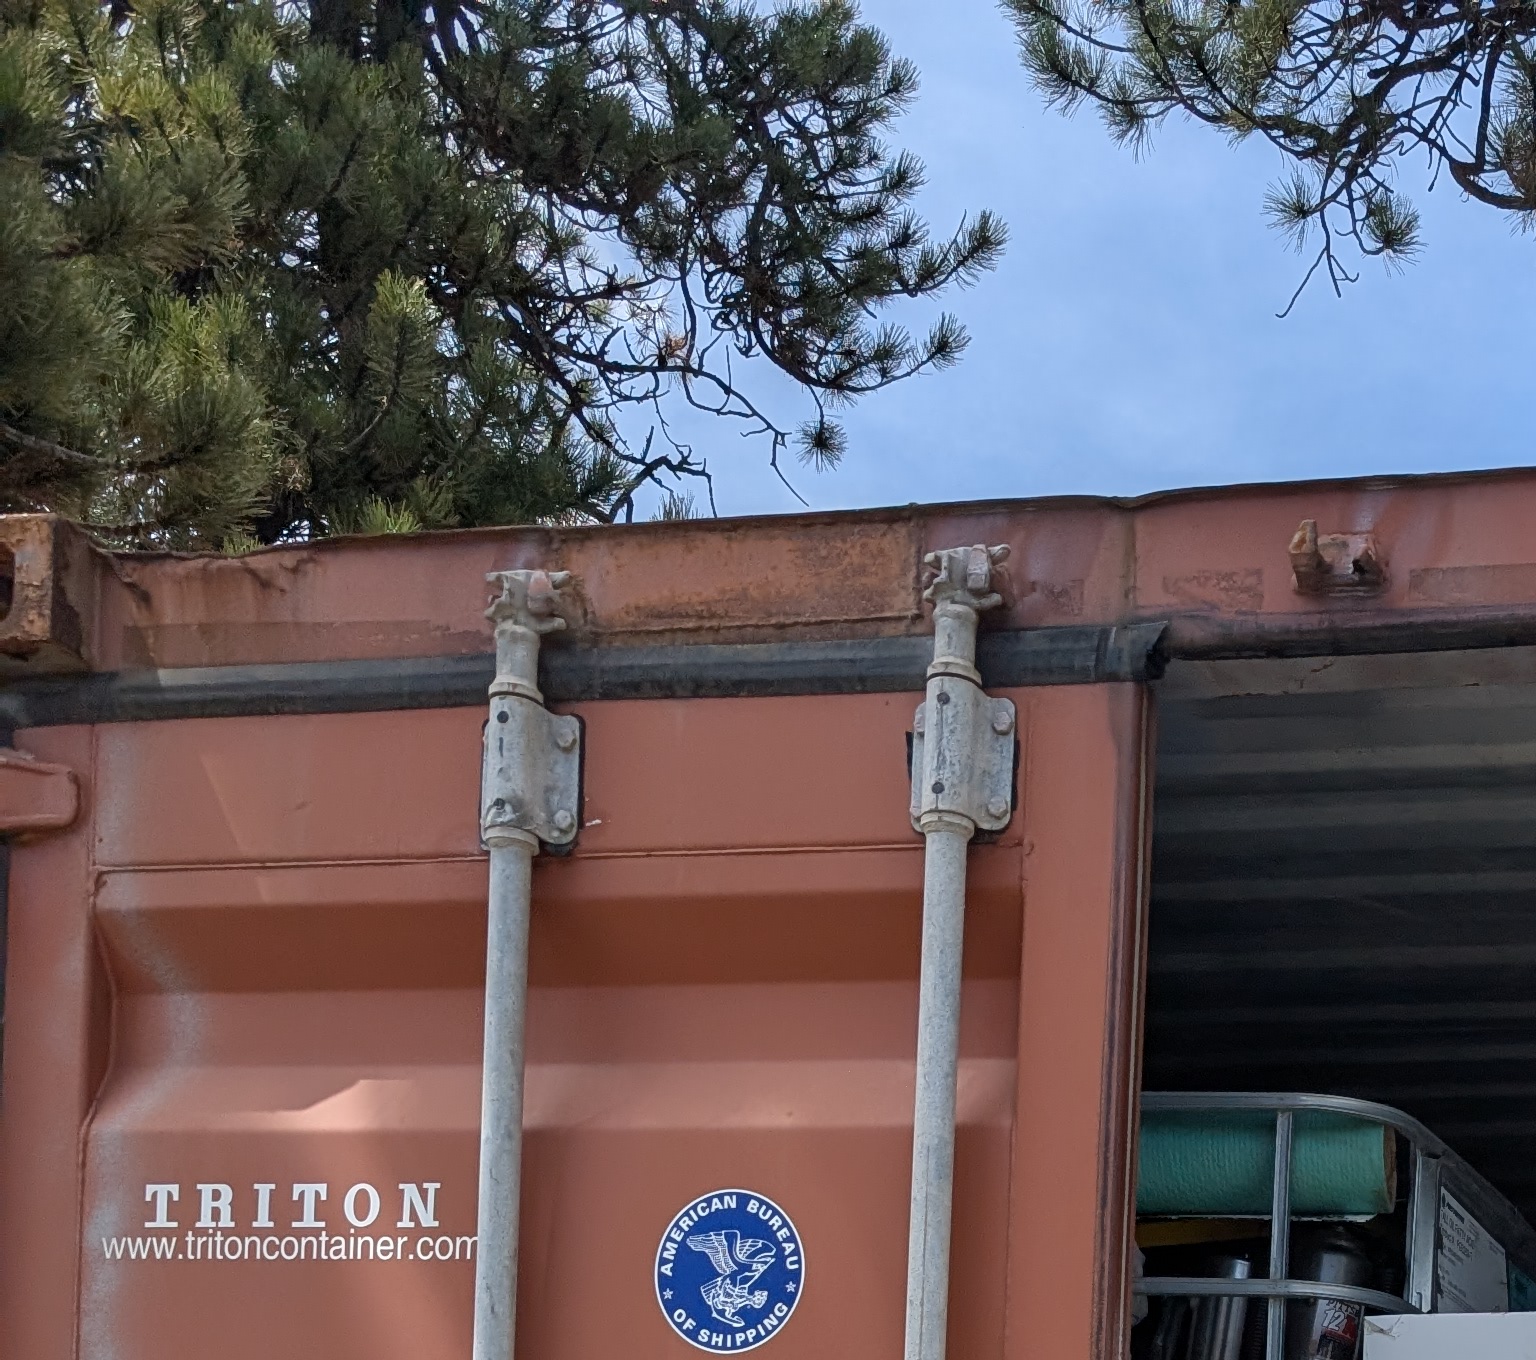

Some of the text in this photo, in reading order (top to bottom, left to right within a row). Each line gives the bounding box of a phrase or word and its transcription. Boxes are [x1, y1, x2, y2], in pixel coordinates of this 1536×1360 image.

[143, 1182, 441, 1228] TRITON
[102, 1229, 479, 1261] www.tritoncontainer.com
[660, 1194, 799, 1277] AMERICAN BUREAU
[673, 1302, 789, 1348] OF SHIPPING
